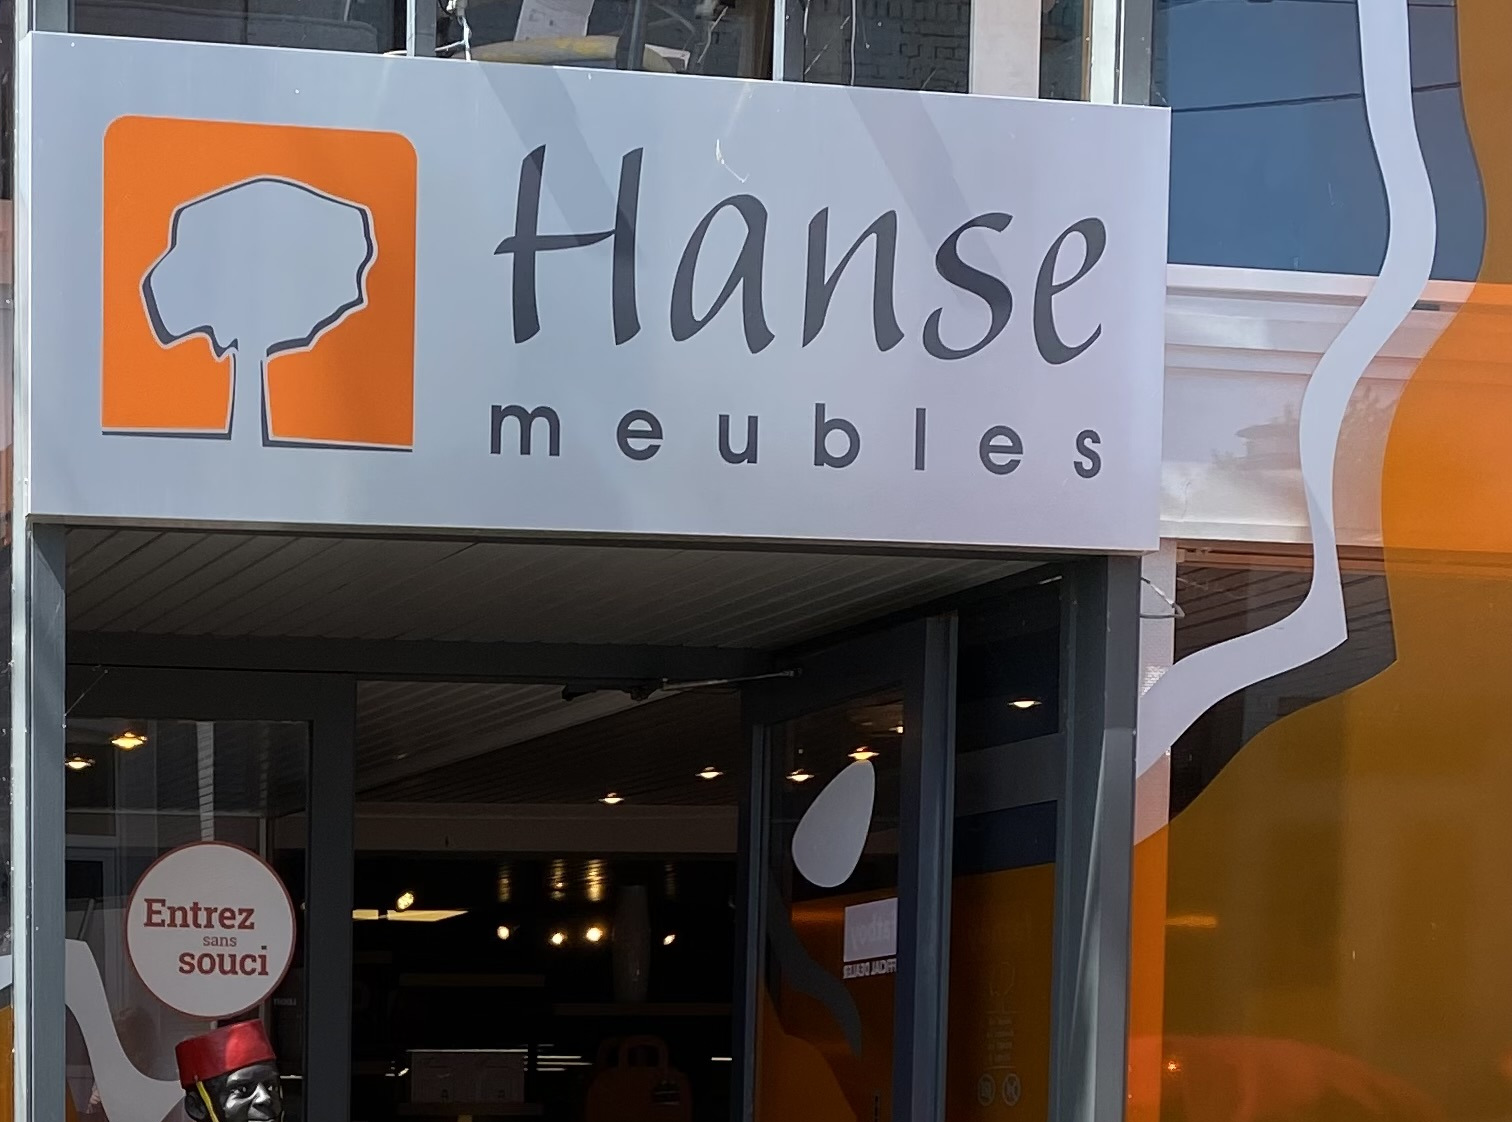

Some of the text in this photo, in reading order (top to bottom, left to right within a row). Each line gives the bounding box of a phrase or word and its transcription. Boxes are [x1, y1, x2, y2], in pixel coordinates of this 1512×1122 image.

[493, 143, 1107, 365] Hanse
[490, 403, 1101, 479] meubles
[143, 898, 255, 930] Entrez
[202, 934, 237, 947] sans
[178, 945, 269, 976] souci
